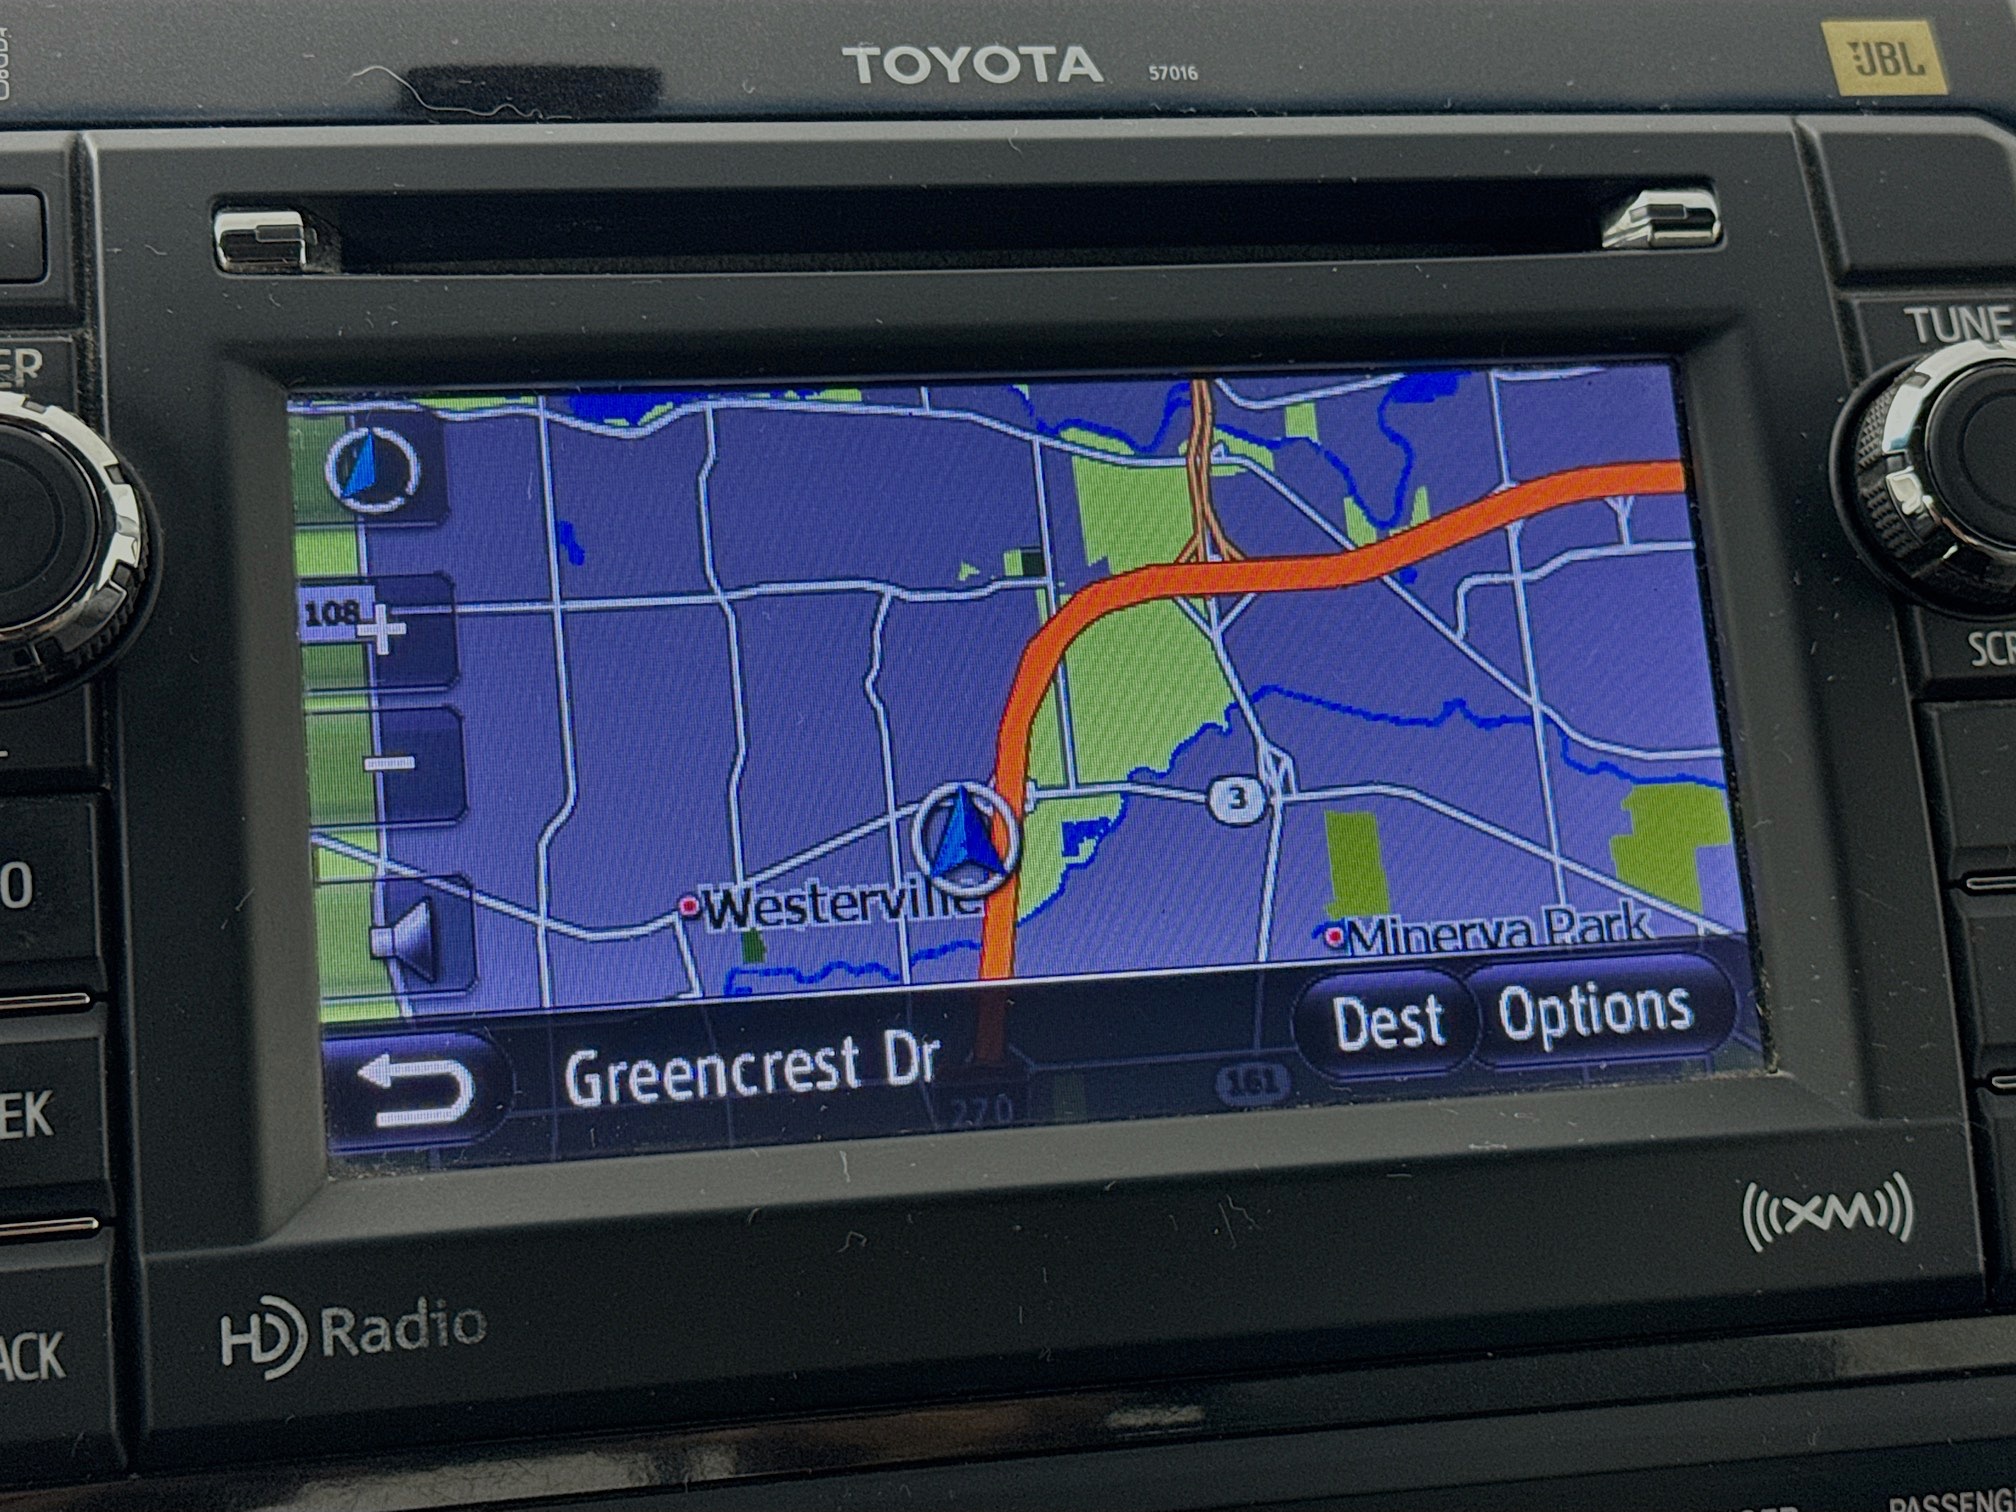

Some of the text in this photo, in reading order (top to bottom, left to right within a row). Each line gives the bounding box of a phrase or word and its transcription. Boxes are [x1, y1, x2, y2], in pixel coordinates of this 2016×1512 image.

[842, 46, 1105, 84] TOYOTA
[1149, 65, 1199, 82] 57016
[1847, 42, 1926, 76] JBL
[305, 600, 360, 627] 108
[1229, 786, 1246, 810] 3
[1349, 898, 1654, 955] Minerva Park
[1334, 981, 1694, 1052] Dest Options
[565, 1028, 941, 1108] Greencrest Dr
[220, 1296, 488, 1377] HD Radio
